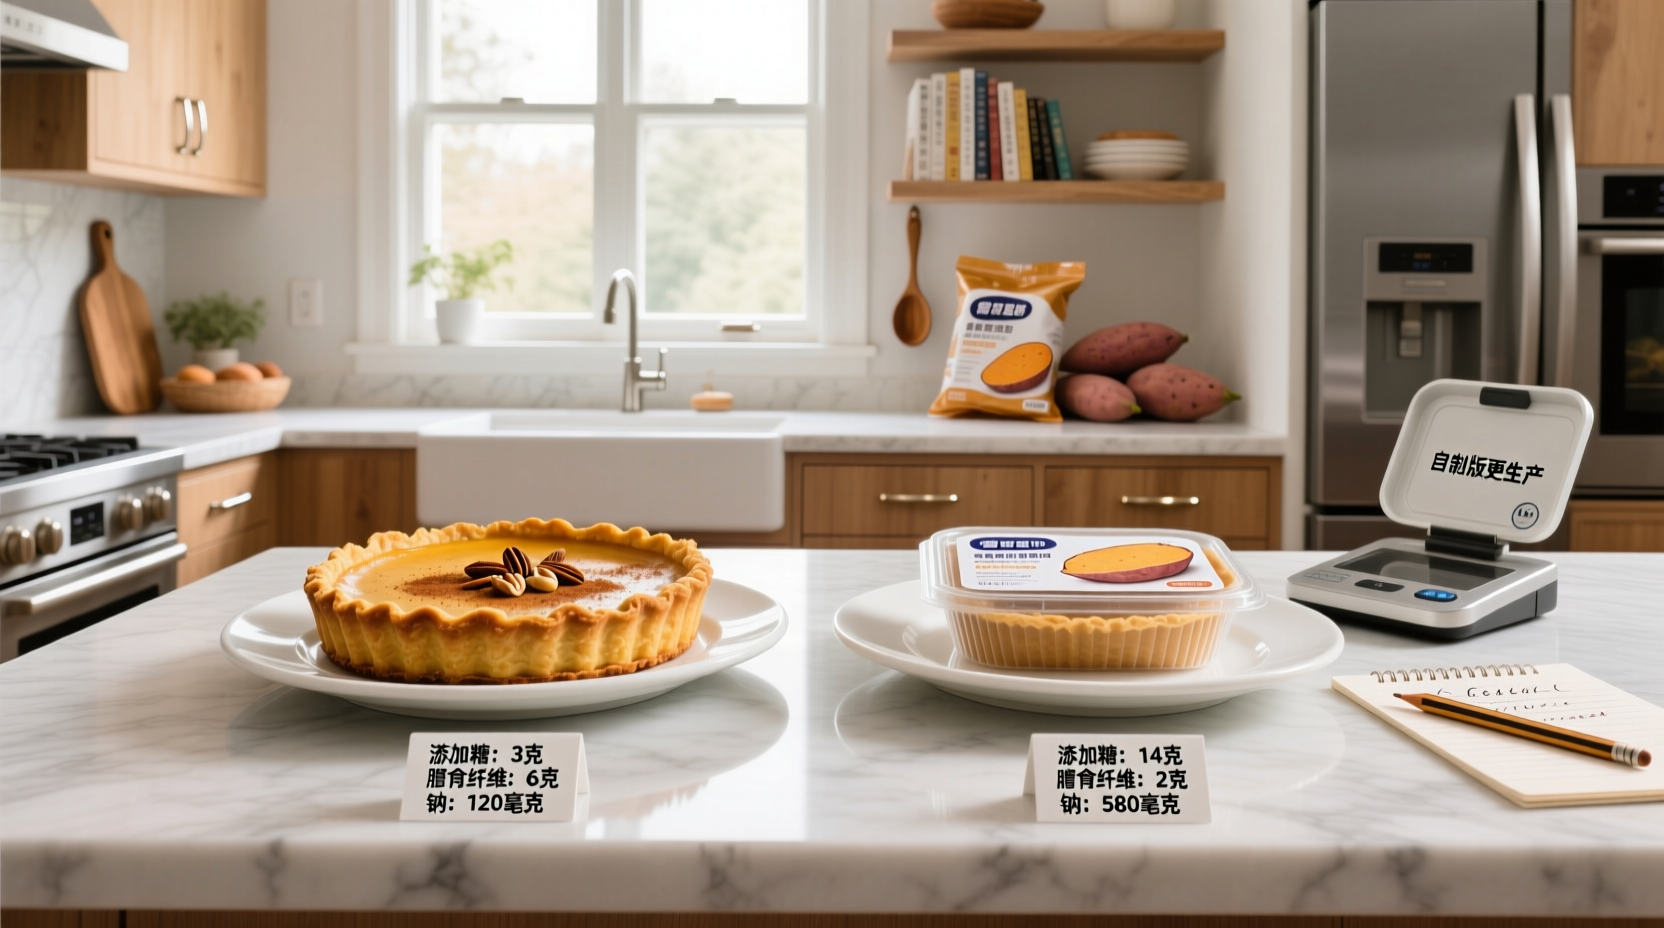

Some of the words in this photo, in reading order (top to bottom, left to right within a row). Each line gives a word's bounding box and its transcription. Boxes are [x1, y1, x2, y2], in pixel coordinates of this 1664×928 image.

[1430, 450, 1545, 486] 自制版更生产
